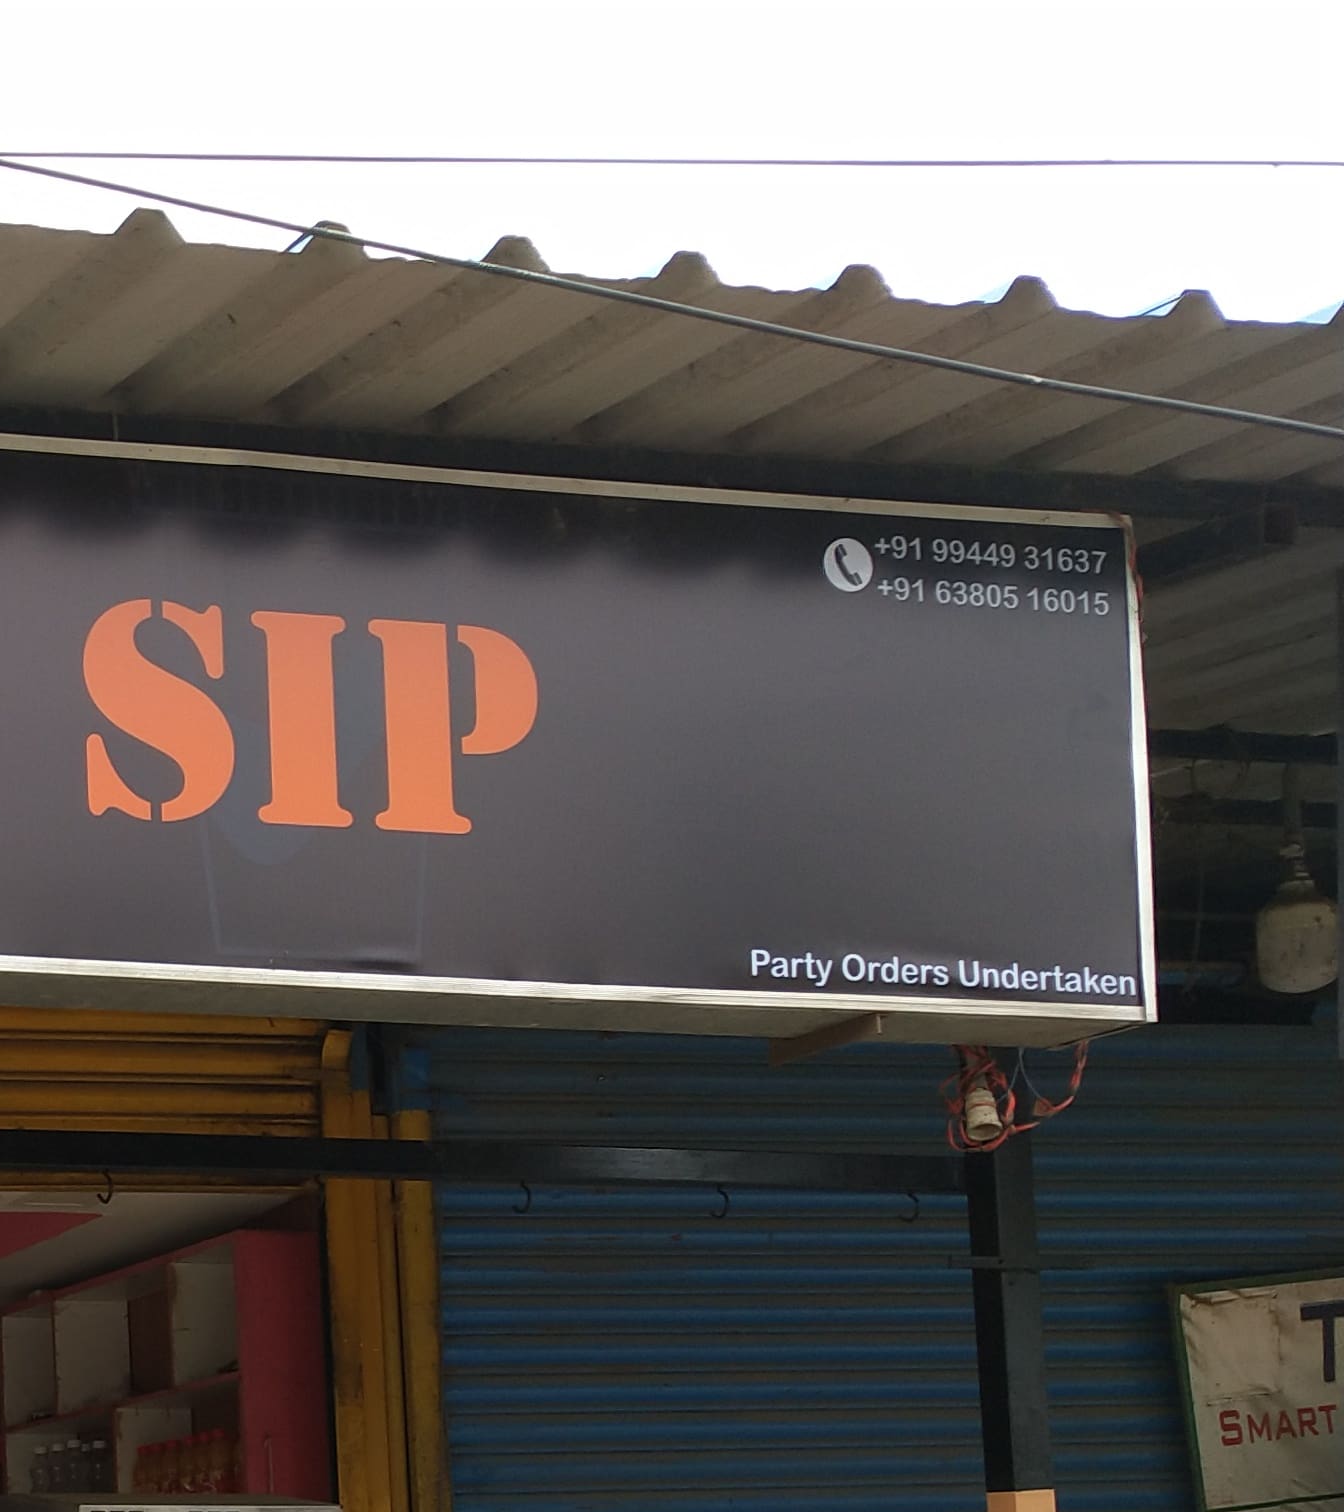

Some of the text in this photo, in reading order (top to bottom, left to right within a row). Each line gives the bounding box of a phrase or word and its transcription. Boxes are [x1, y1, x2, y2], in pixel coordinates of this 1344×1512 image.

[875, 535, 1107, 574] +91 99449 31637
[877, 578, 1110, 616] +91 63805 16015
[82, 598, 539, 835] SIP
[751, 949, 1137, 997] Party Orders Undertaken
[1219, 1405, 1337, 1446] SMART
